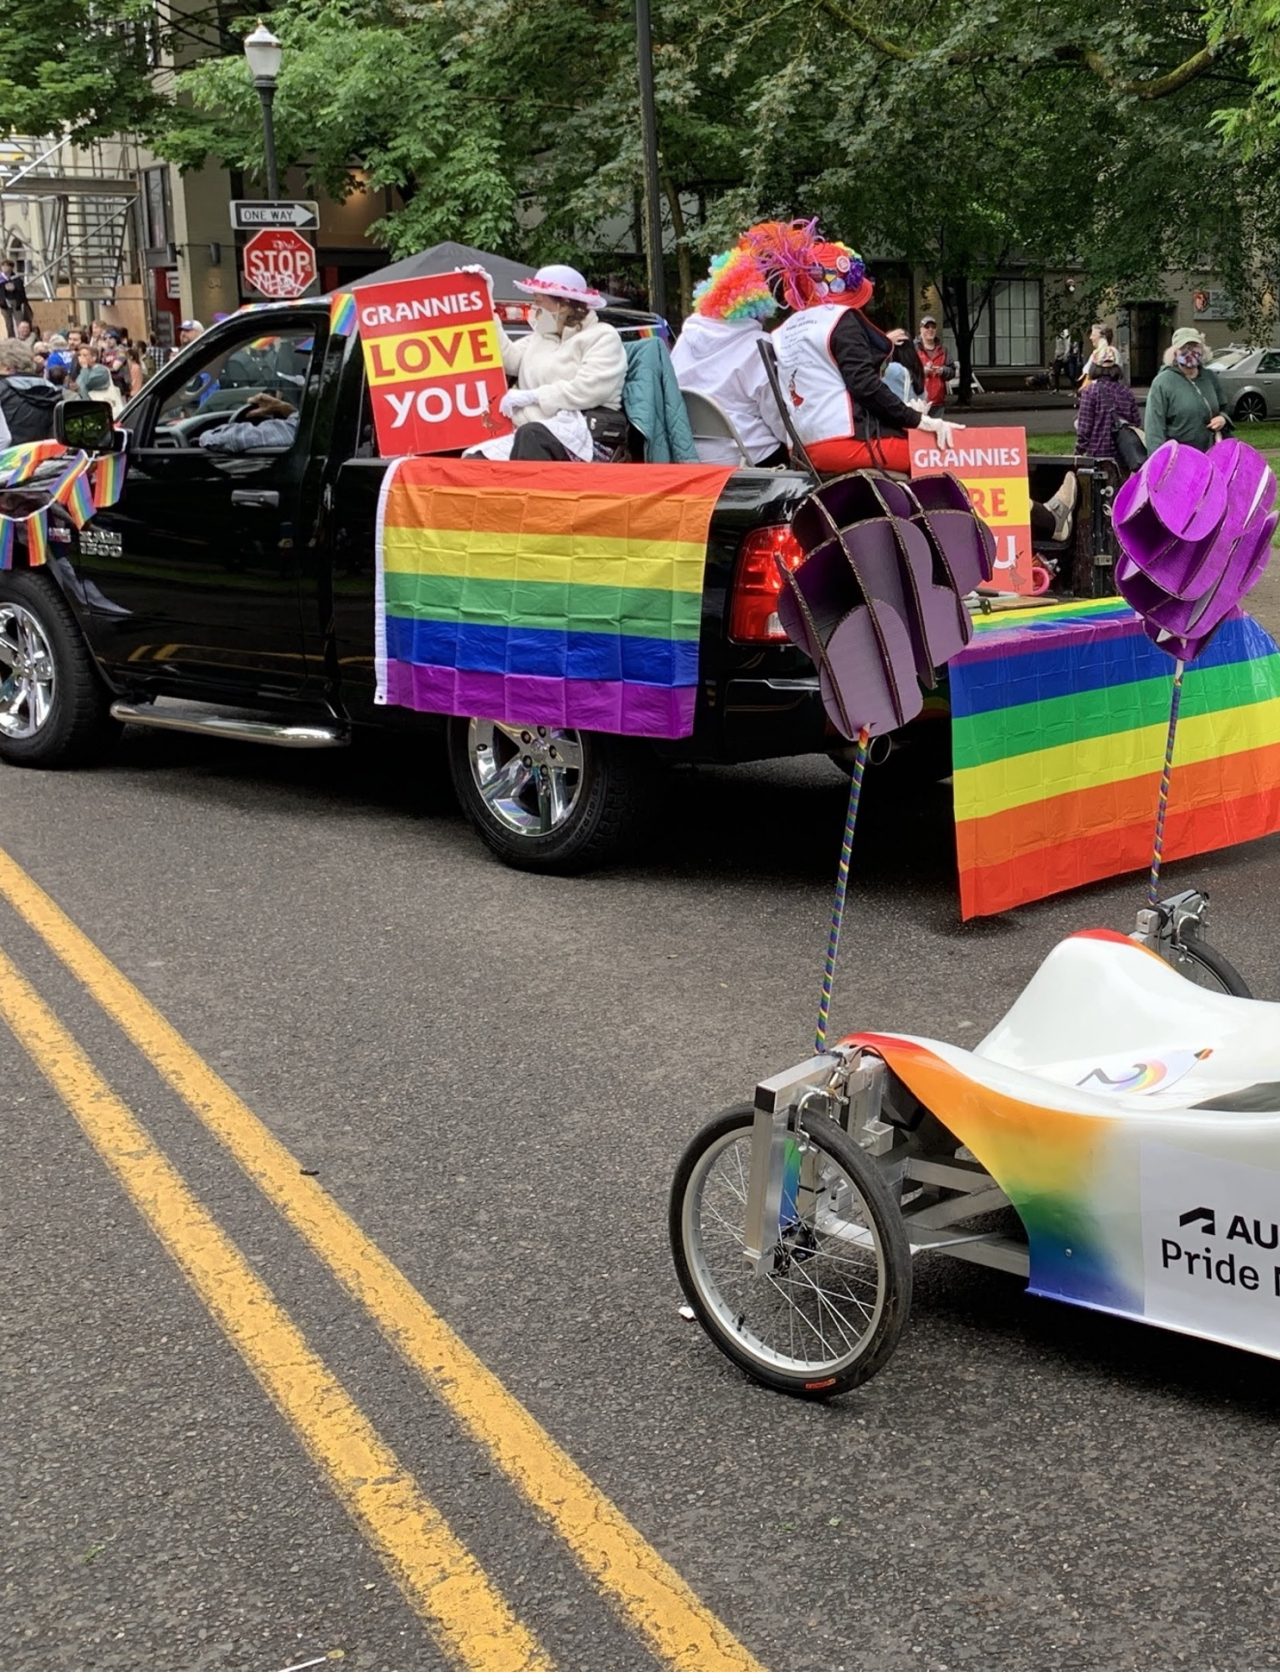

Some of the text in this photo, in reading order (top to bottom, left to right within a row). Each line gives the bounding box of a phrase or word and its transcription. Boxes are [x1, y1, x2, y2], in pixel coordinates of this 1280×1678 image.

[243, 210, 294, 221] ONE WAY
[250, 250, 310, 275] STOP
[361, 291, 484, 327] GRANNIES
[370, 328, 494, 378] LOVE
[384, 380, 490, 428] YOU
[914, 448, 1021, 468] GRANNIES
[968, 487, 1008, 518] RE
[80, 542, 123, 557] 1500
[1161, 1238, 1260, 1290] Pride
